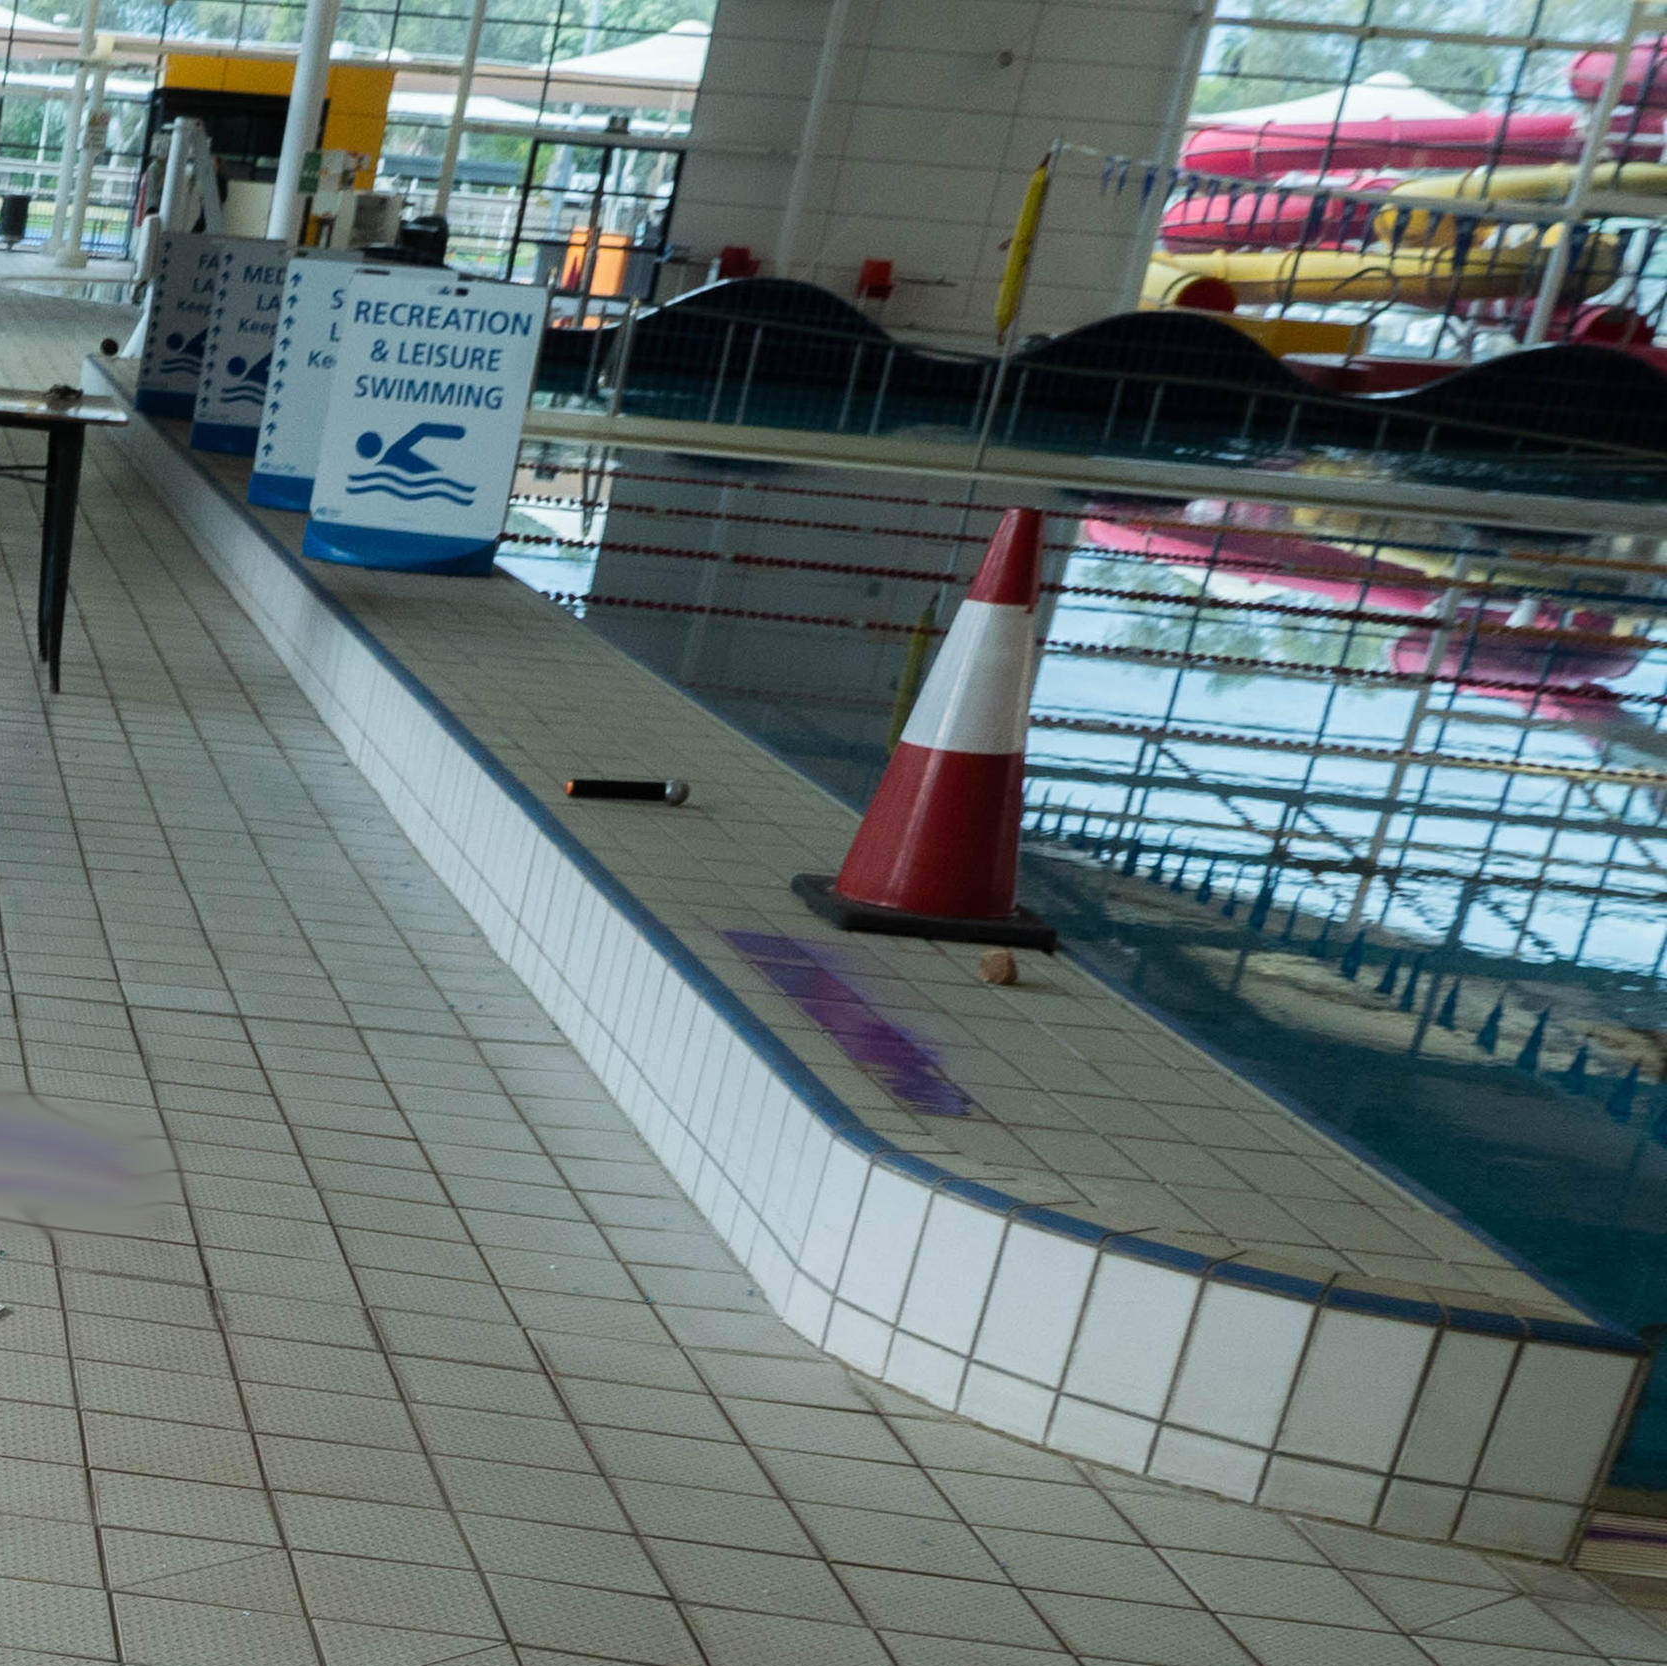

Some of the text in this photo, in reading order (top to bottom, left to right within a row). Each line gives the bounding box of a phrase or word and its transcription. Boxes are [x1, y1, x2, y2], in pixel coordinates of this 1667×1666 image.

[198, 253, 218, 270] FA
[242, 265, 288, 285] MED
[193, 277, 215, 294] LA
[256, 294, 282, 313] LA
[353, 300, 533, 337] RECREATION
[370, 338, 503, 372] & LEISURE
[354, 374, 504, 410] SWIMMING
